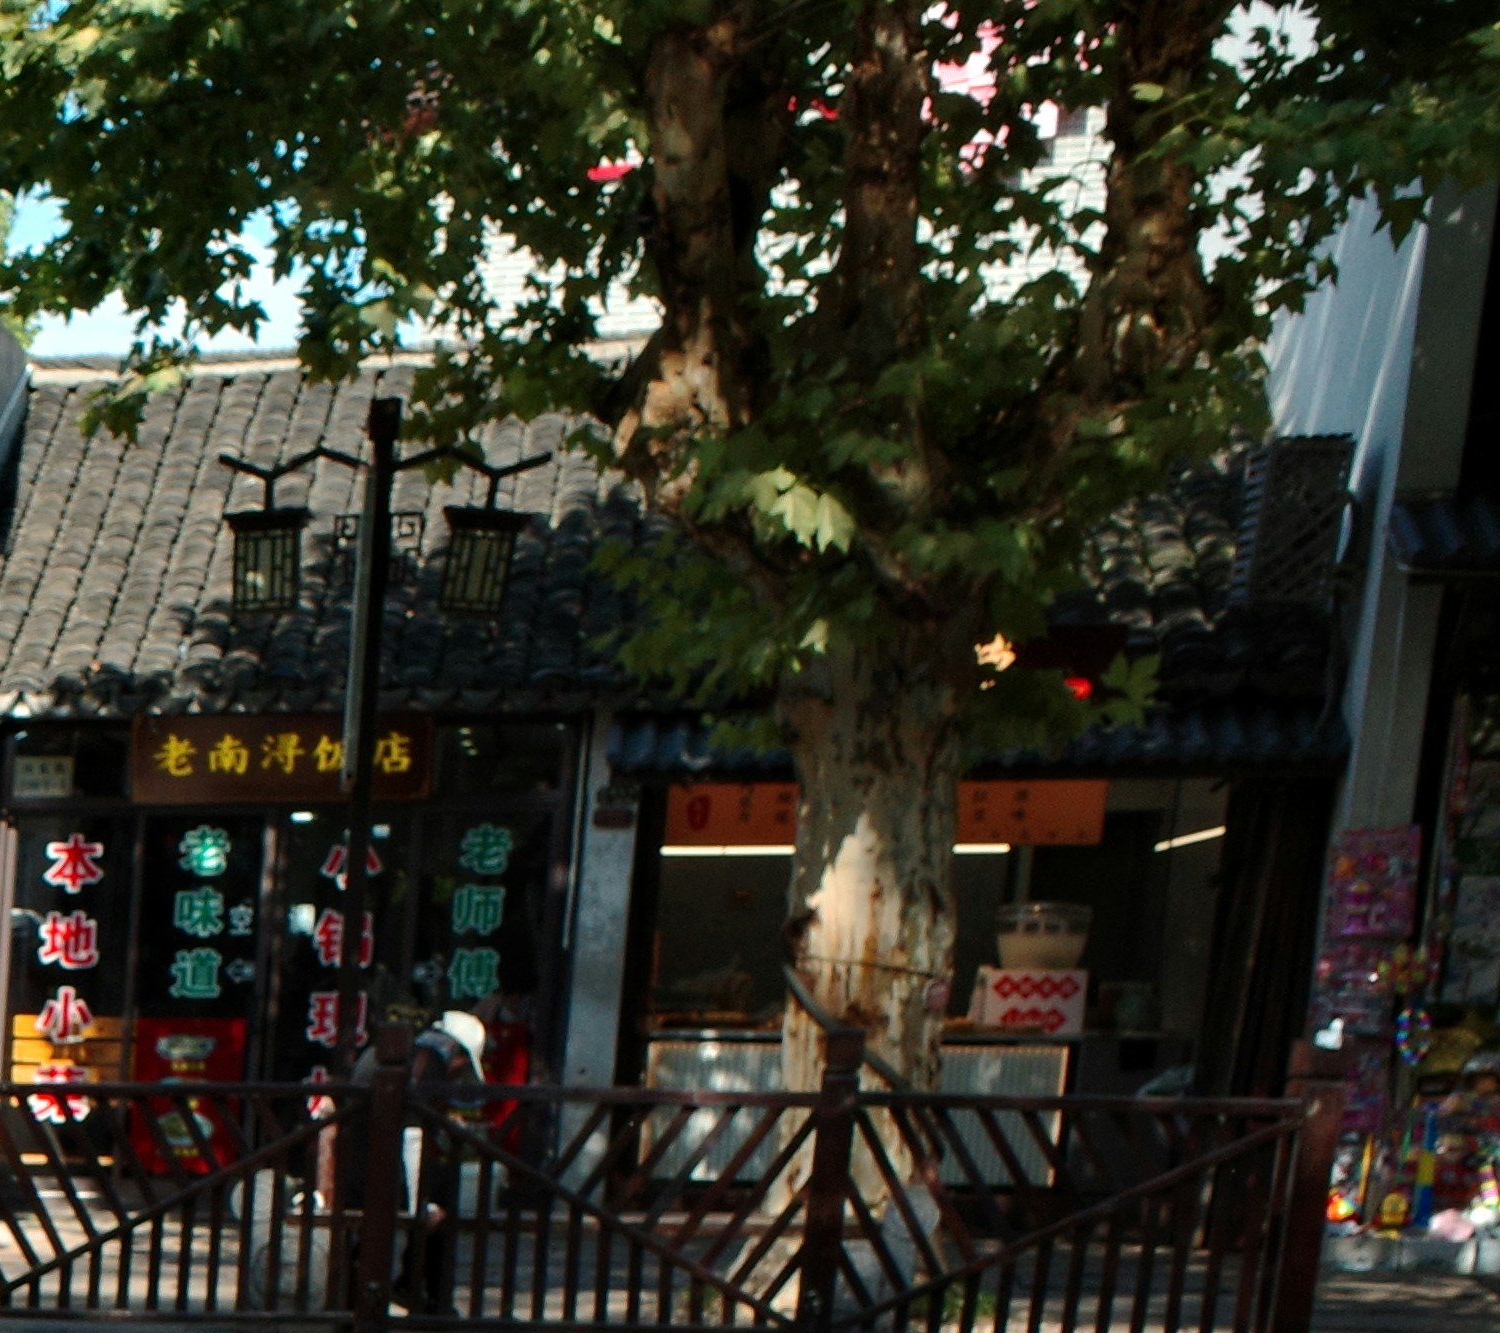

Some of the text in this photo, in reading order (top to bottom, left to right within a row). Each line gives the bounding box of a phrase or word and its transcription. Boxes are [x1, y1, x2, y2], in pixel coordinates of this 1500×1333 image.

[153, 732, 414, 777] 老南浔饭店
[27, 834, 104, 1125] 本地小菜
[169, 825, 231, 998] 老味道
[449, 823, 512, 999] 老师傅
